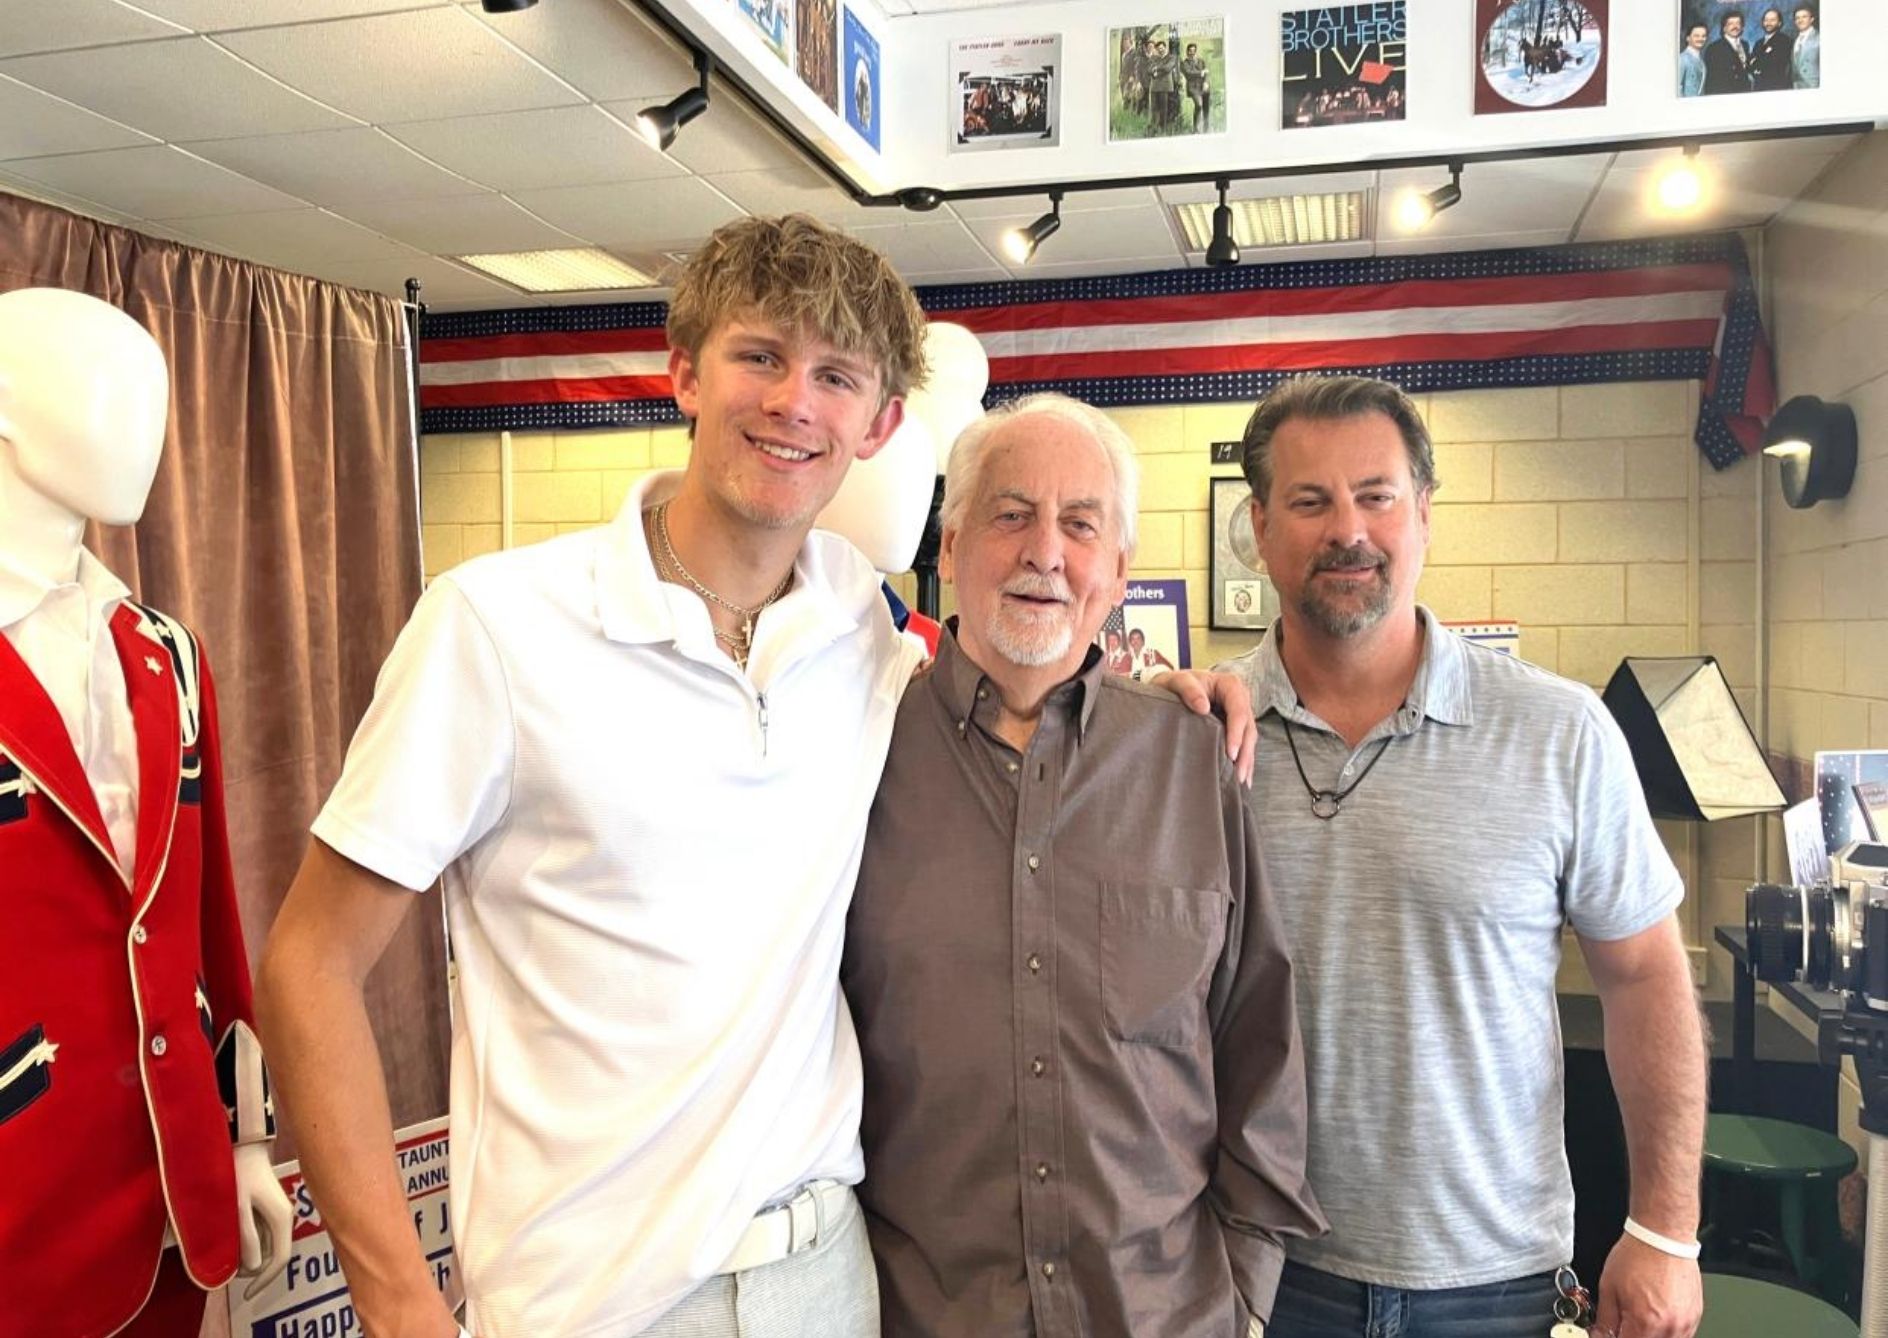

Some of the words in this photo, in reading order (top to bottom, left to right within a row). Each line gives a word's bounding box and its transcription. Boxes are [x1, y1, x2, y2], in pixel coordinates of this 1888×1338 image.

[1282, 1, 1405, 32] STATLER
[1281, 20, 1405, 51] BROTHERS
[1280, 41, 1406, 81] LIVE
